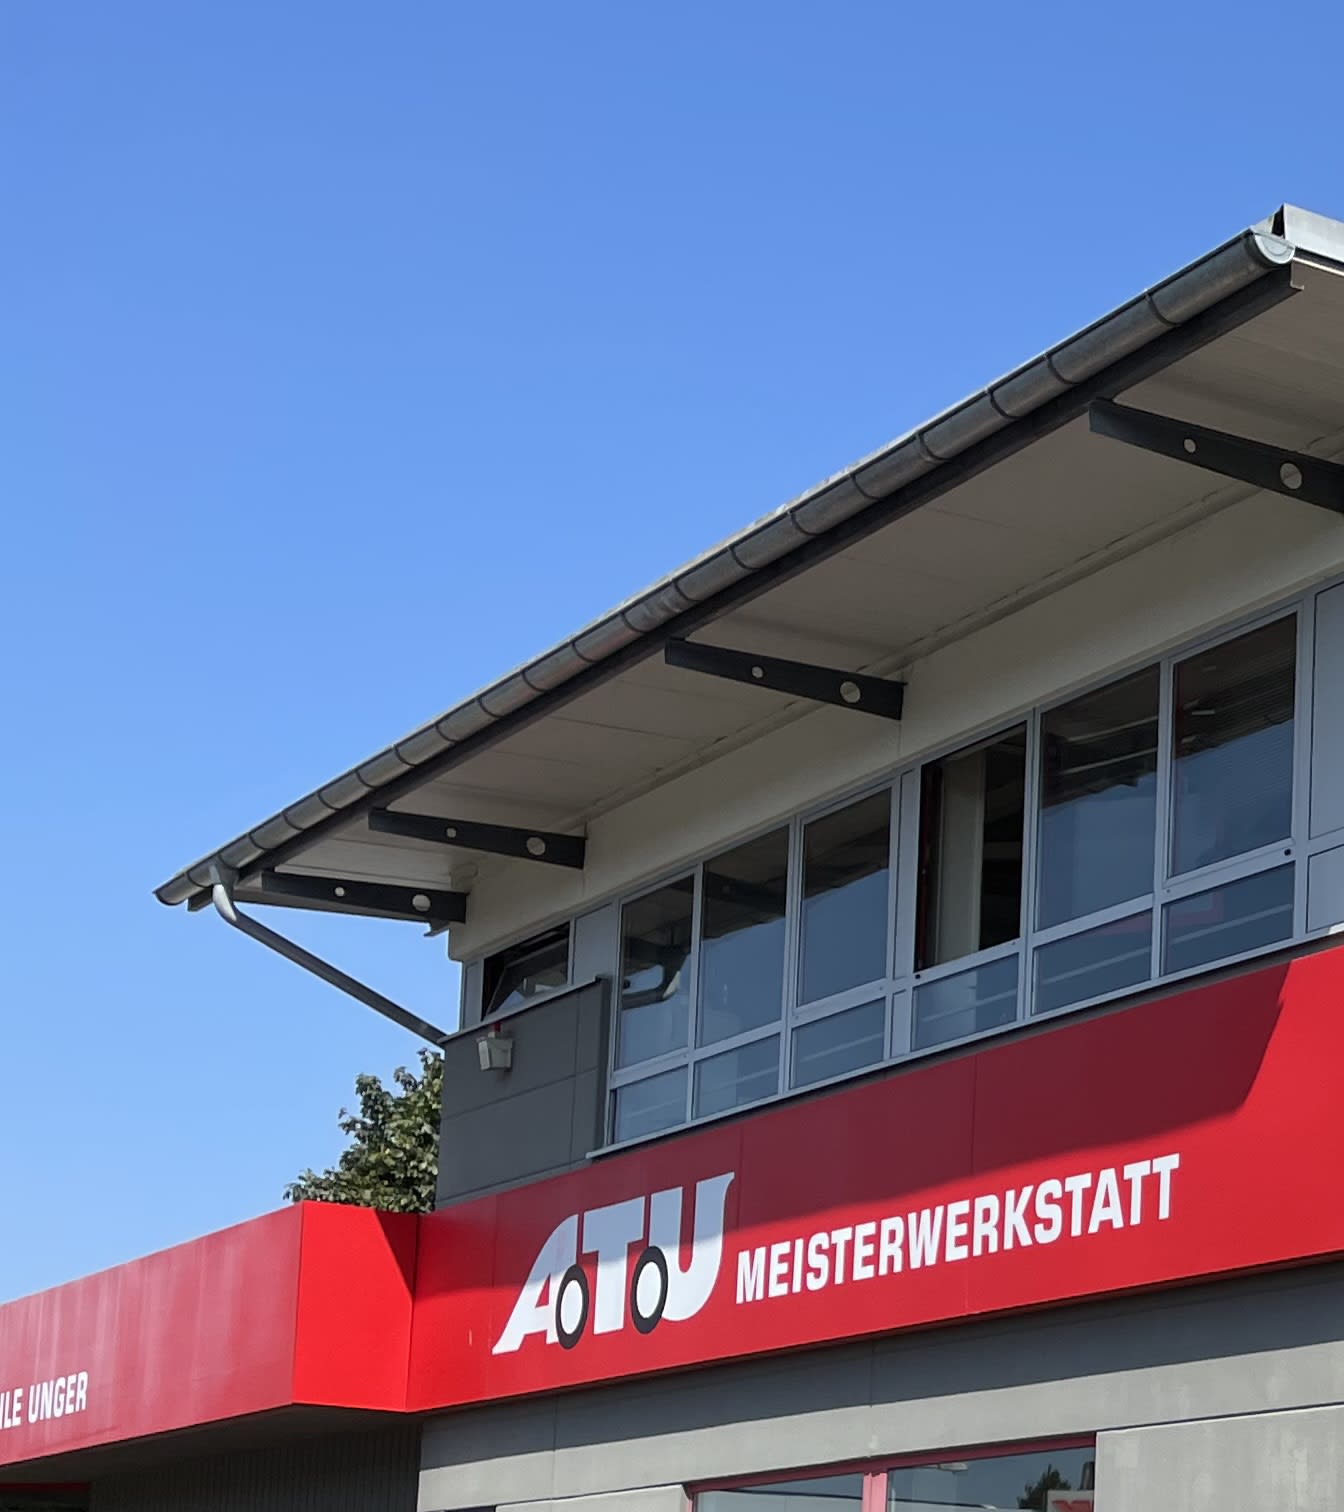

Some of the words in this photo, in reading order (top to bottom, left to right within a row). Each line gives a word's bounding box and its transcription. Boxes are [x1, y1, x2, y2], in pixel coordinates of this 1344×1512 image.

[492, 1172, 735, 1355] ATU
[736, 1152, 1180, 1304] MEISTERWERKSTATT
[28, 1371, 88, 1424] UNGER
